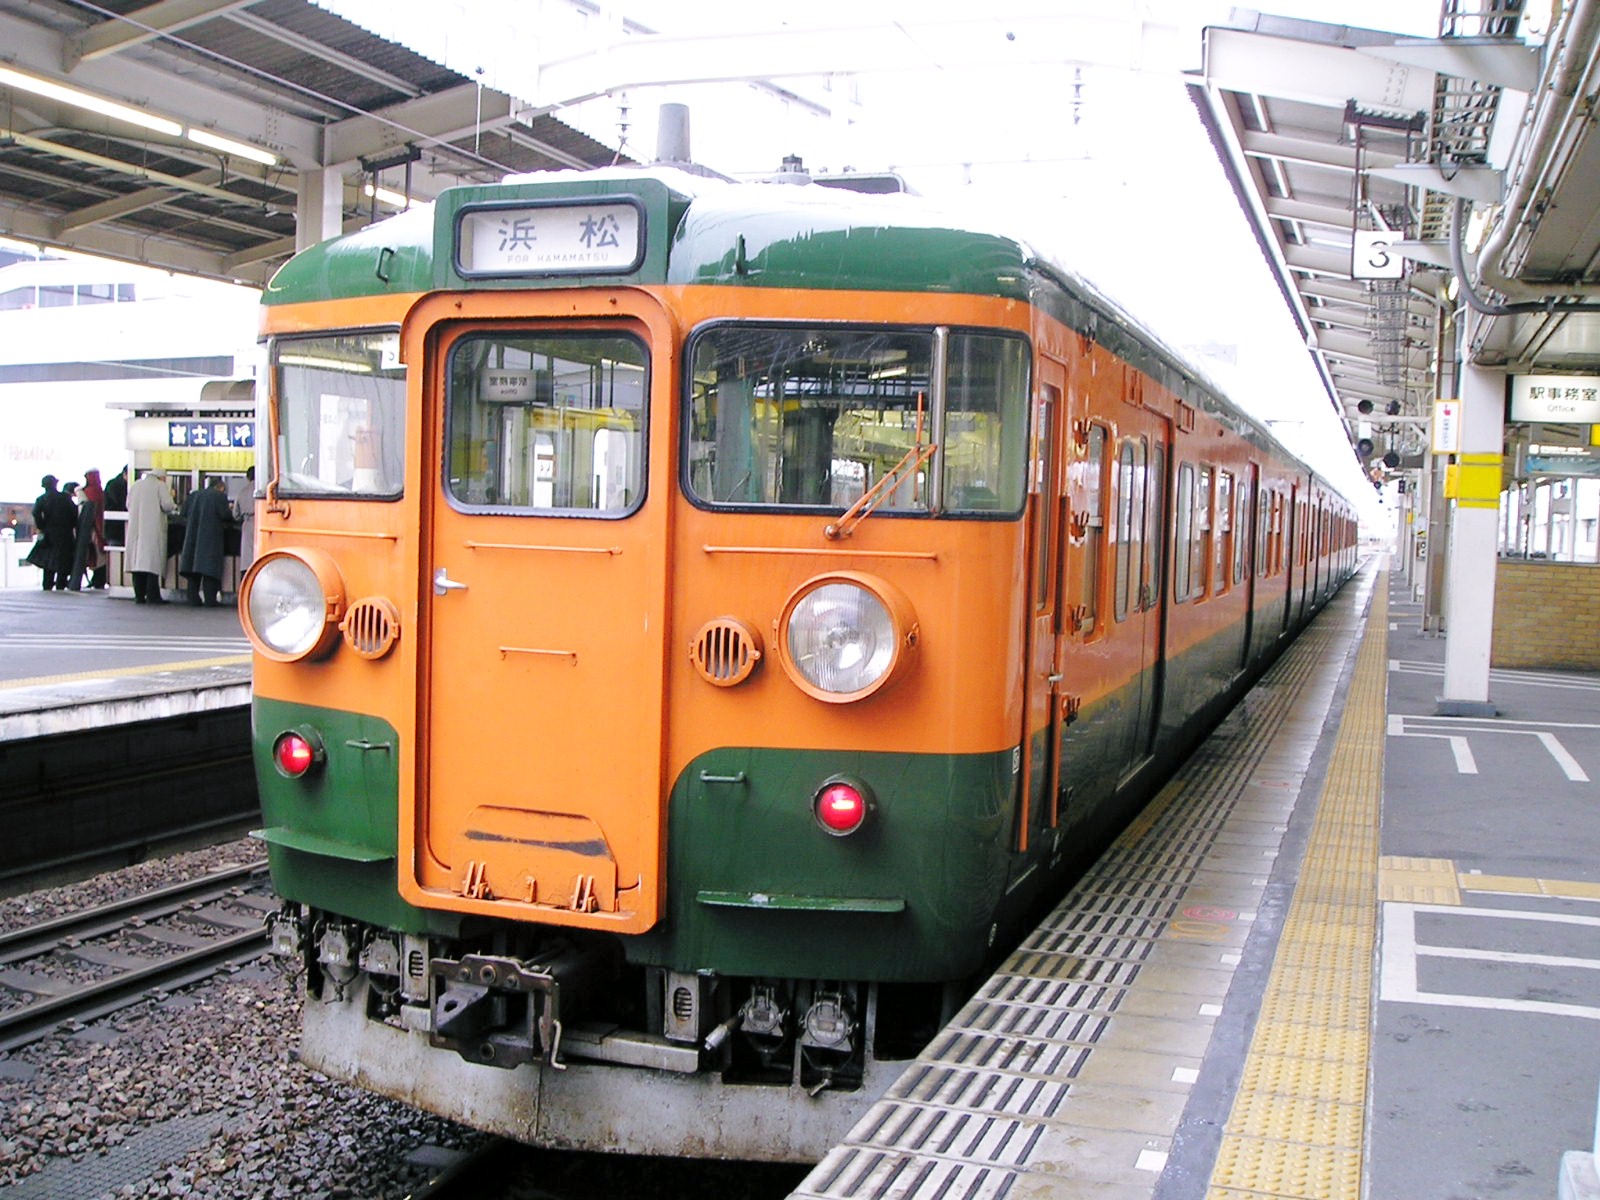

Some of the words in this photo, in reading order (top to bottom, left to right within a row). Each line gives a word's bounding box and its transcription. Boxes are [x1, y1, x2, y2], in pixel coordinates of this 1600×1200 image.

[498, 213, 621, 252] 浜松
[507, 255, 530, 265] FOR
[537, 252, 609, 264] HAMAMATSU
[1368, 240, 1390, 268] 3
[1529, 386, 1598, 402] 駅事務室
[1547, 404, 1576, 413] Office
